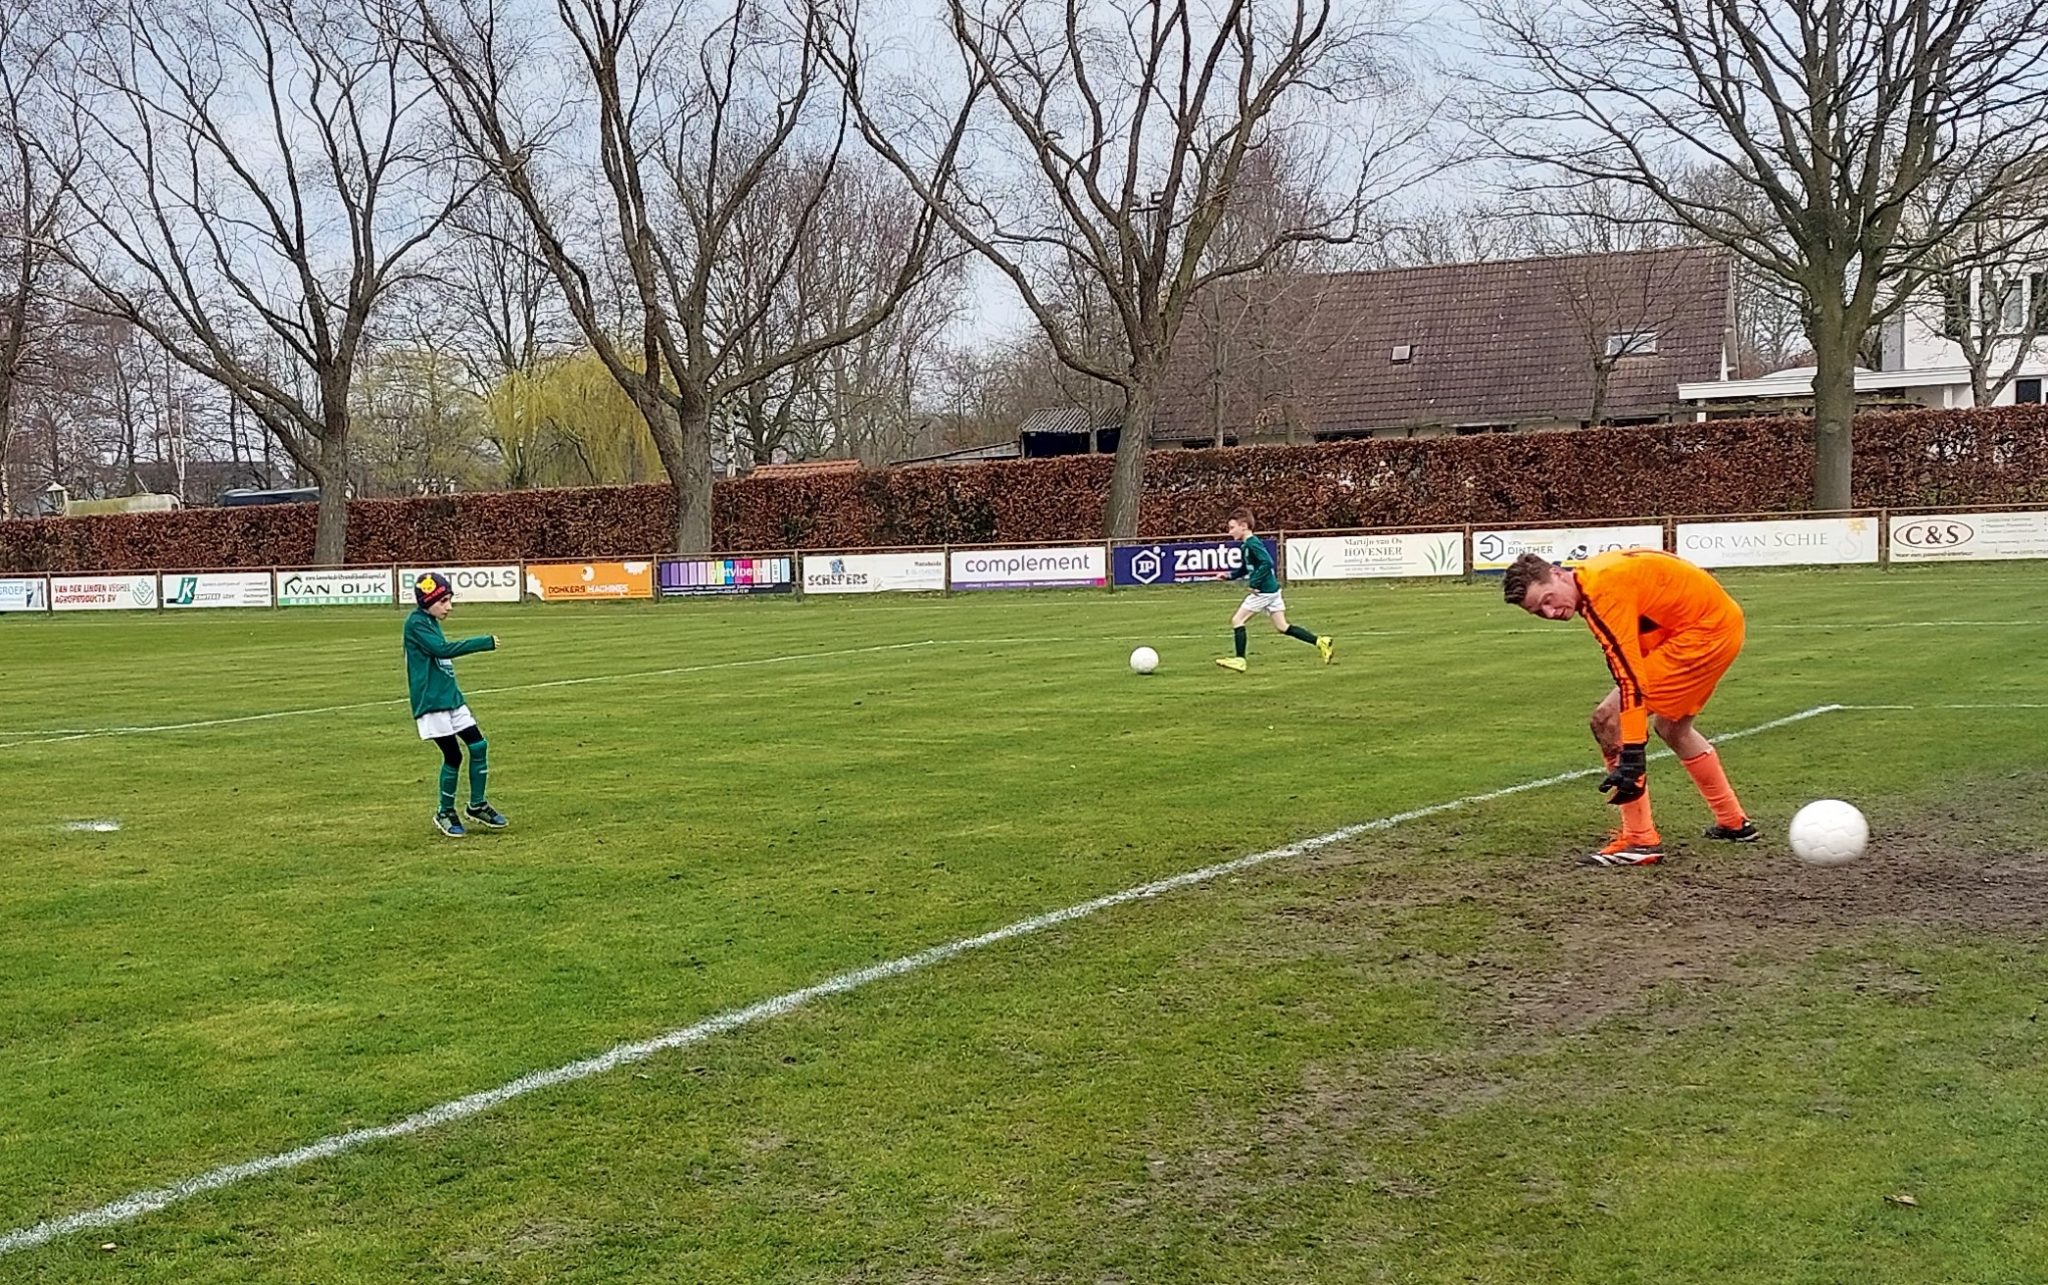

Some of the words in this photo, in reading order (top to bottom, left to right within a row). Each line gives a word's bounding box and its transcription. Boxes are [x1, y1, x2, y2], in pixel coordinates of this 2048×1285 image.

[1685, 534, 1725, 550] COR
[1773, 532, 1828, 547] SCHIE
[1344, 547, 1403, 557] HOVENIER
[965, 554, 1091, 576] complement
[290, 584, 330, 595] VAN
[341, 583, 386, 594] DIJK
